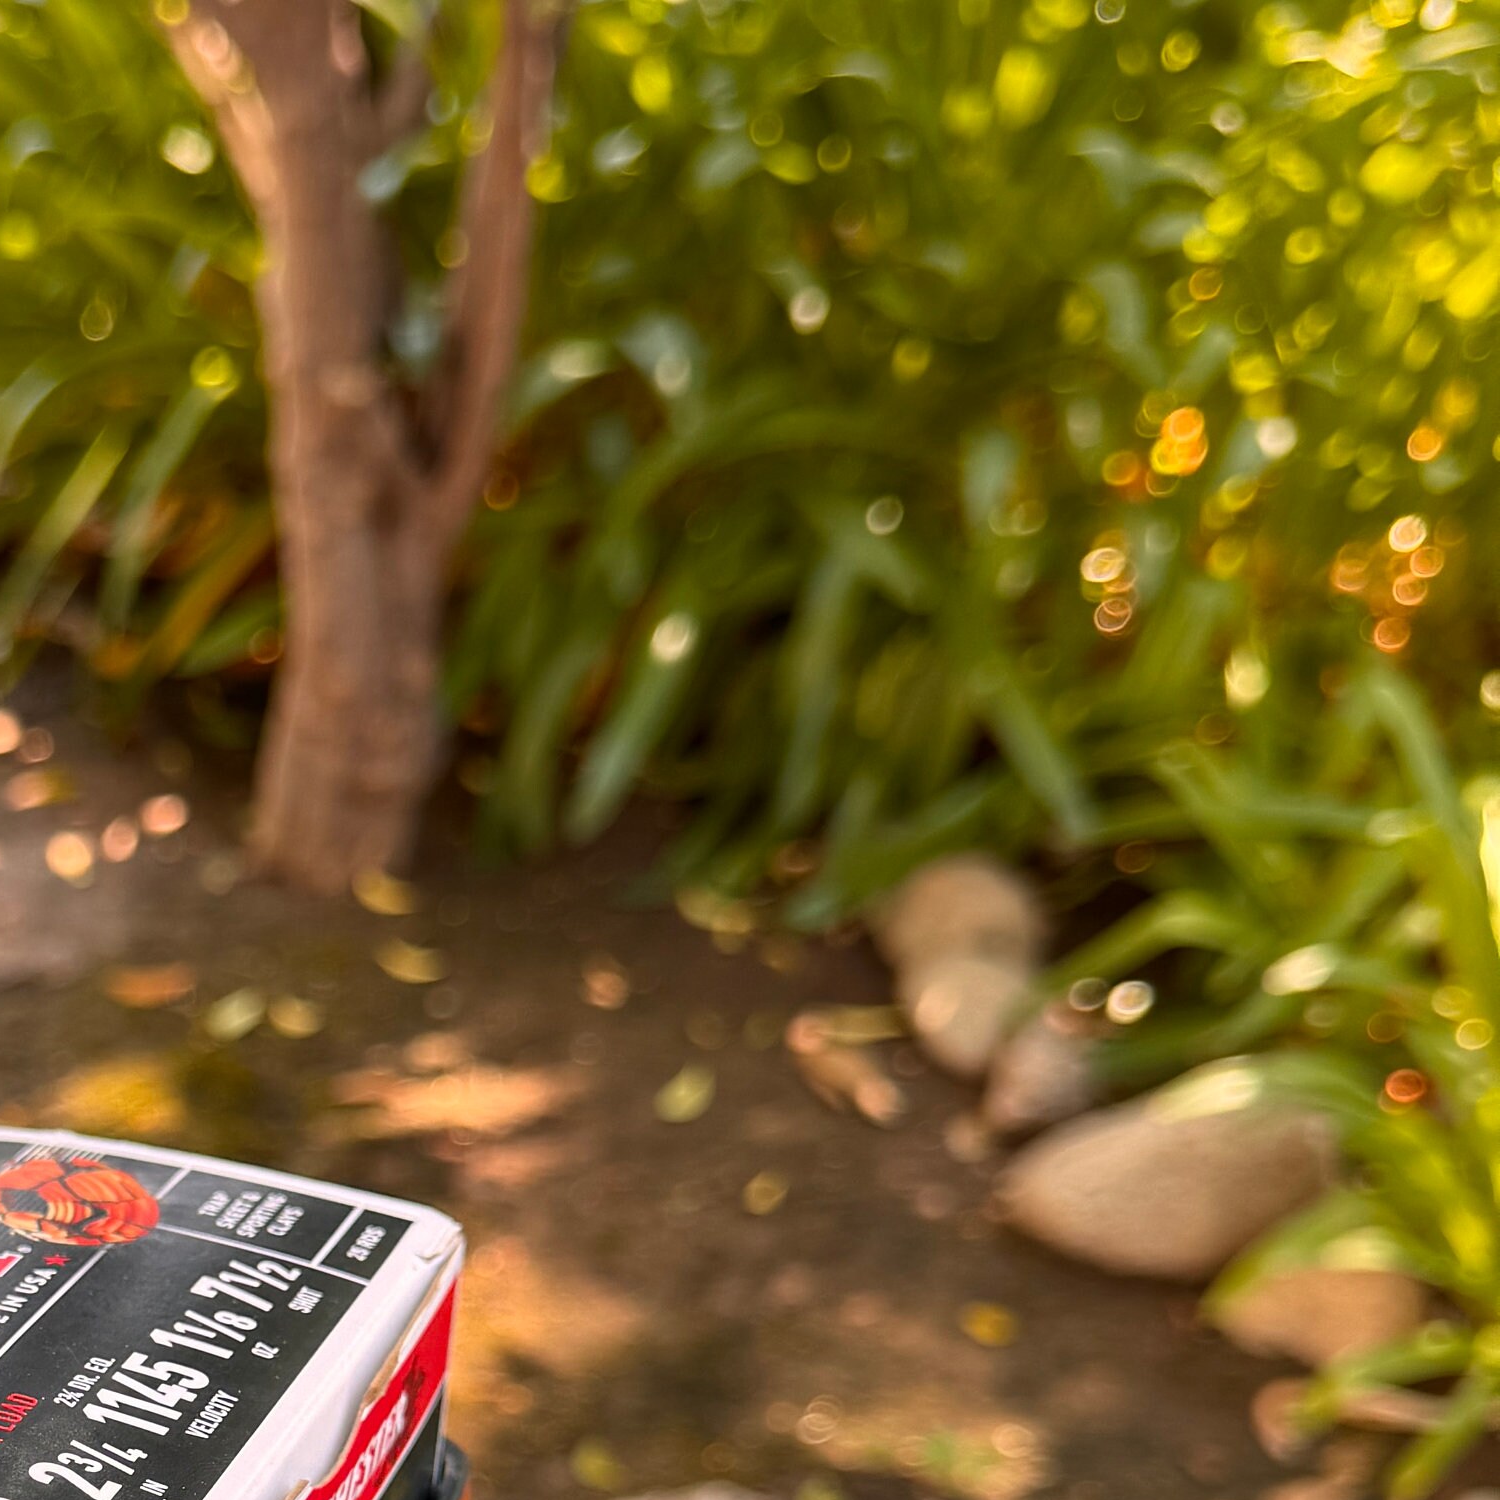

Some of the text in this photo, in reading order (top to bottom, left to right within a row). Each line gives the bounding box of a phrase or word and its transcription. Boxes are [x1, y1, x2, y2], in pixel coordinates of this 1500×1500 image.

[236, 1192, 288, 1238] SPORTING
[266, 1205, 305, 1236] CLAYS
[346, 1224, 387, 1262] 25 RDS
[1, 1294, 29, 1316] IN
[15, 1267, 58, 1295] USA
[67, 1374, 101, 1392] DR.
[83, 1357, 116, 1374] EQ.
[82, 1351, 210, 1436] 1145
[139, 1479, 169, 1497] IN
[184, 1389, 240, 1440] VELOCITY
[251, 1341, 280, 1360] OZ
[287, 1285, 324, 1314] SHOT
